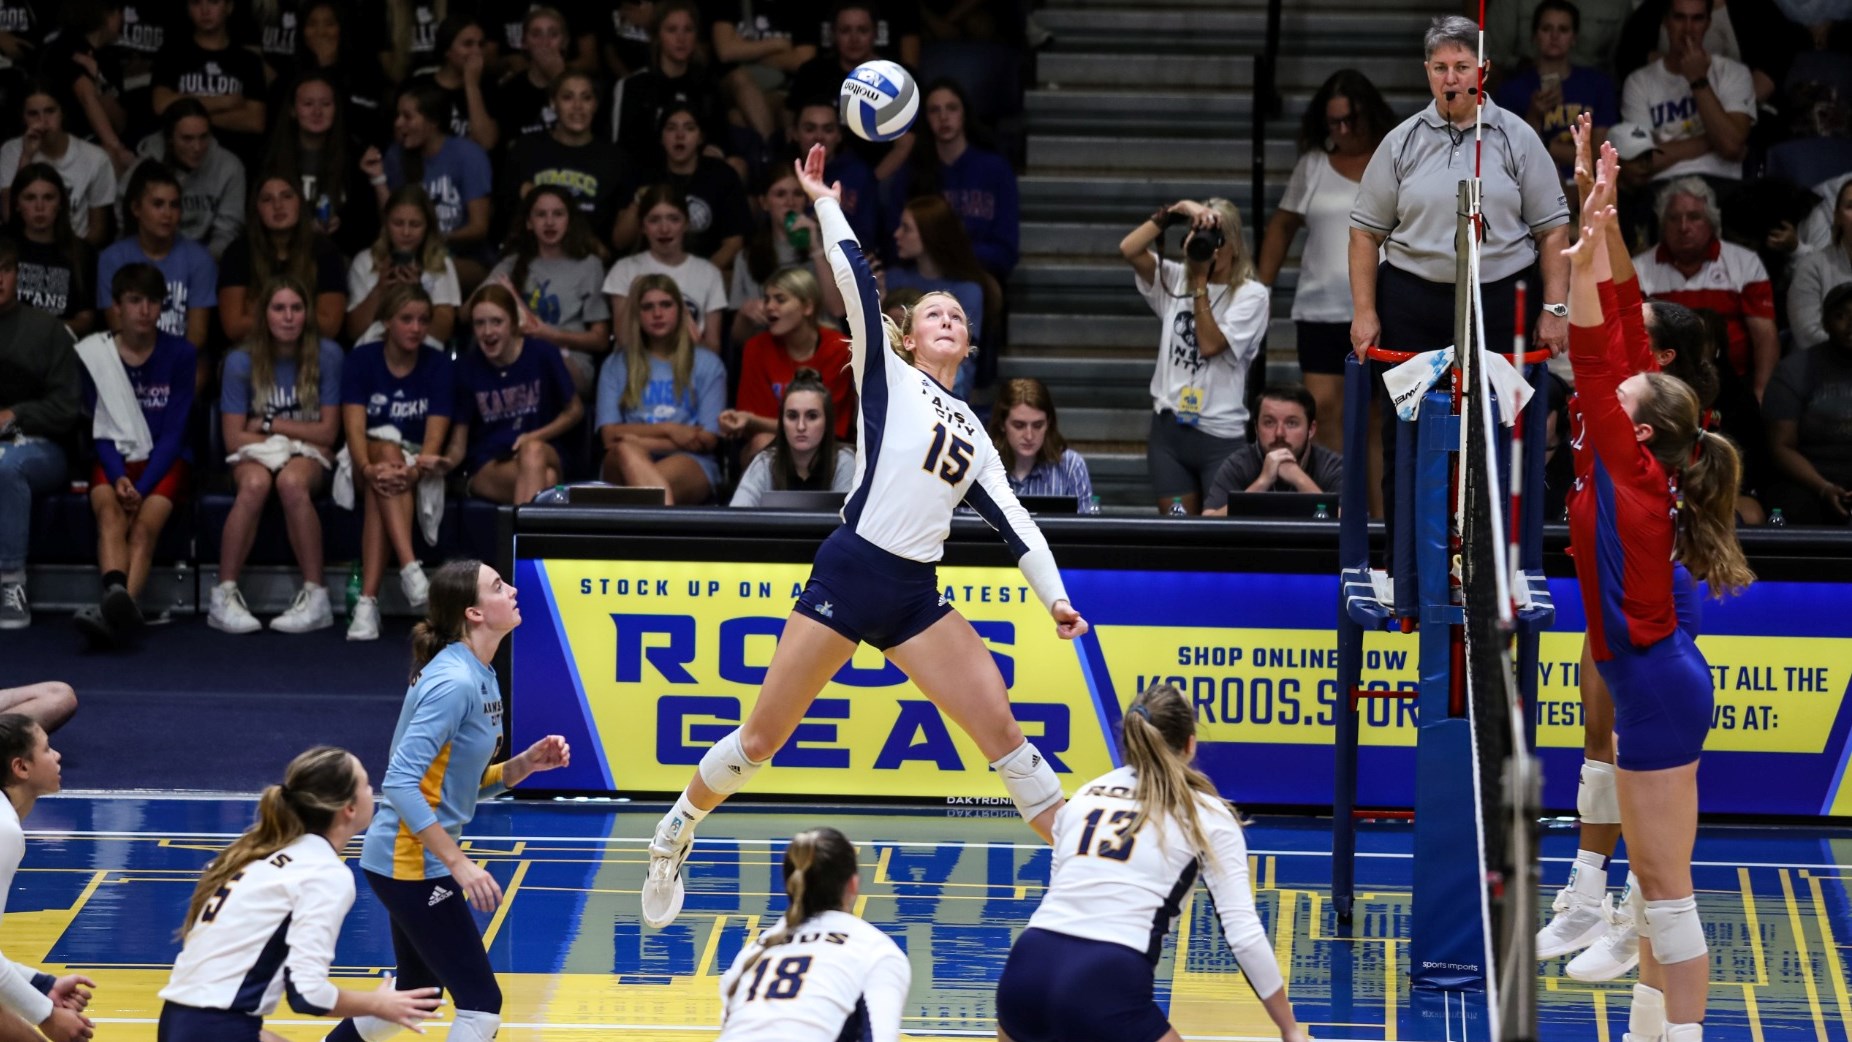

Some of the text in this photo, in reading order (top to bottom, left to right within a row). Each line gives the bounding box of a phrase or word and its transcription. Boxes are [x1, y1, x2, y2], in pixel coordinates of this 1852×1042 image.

[844, 81, 880, 101] molten
[474, 379, 542, 419] KANSA
[922, 421, 976, 488] 15
[580, 578, 669, 596] STOCK
[688, 579, 721, 598] UP
[739, 581, 772, 599] ON
[943, 585, 1030, 603] ATEST
[1178, 646, 1408, 671] SHOP ONLINE OW
[1735, 665, 1778, 692] ALL
[1783, 667, 1829, 693] THE
[1536, 700, 1585, 727] TEST
[1742, 705, 1778, 731] AT:
[656, 694, 1074, 774] GEAR
[946, 796, 1014, 805] DAKTRONI
[1075, 807, 1145, 864] 13
[745, 953, 815, 1003] 18
[1422, 961, 1479, 972] sports imports
